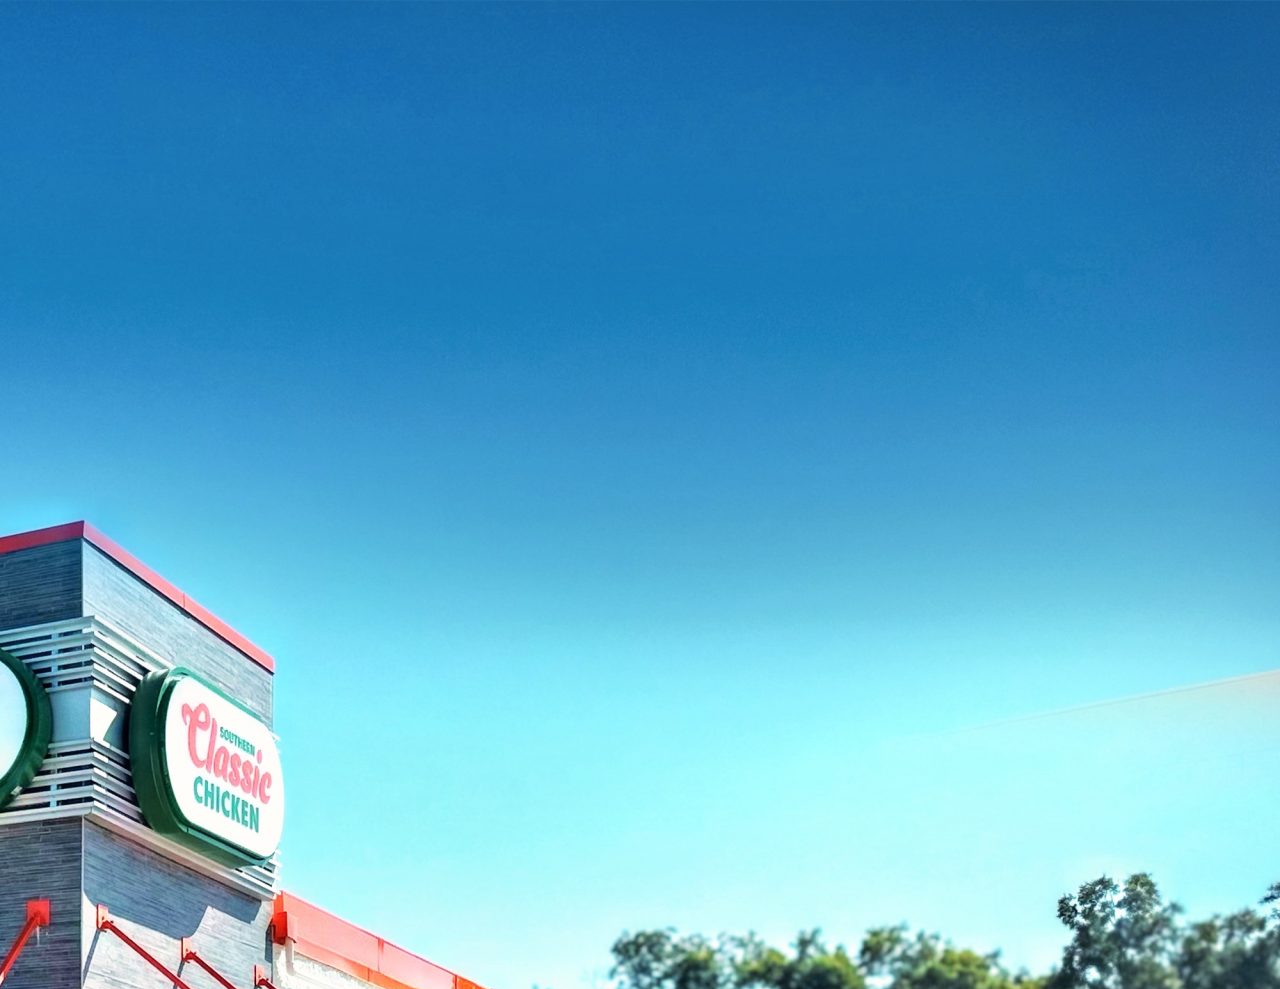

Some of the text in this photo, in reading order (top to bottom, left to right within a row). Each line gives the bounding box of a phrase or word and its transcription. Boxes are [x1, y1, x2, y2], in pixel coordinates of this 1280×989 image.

[181, 703, 272, 805] Classic
[220, 726, 255, 757] SOUTHERN
[193, 776, 260, 833] CHICKEN
